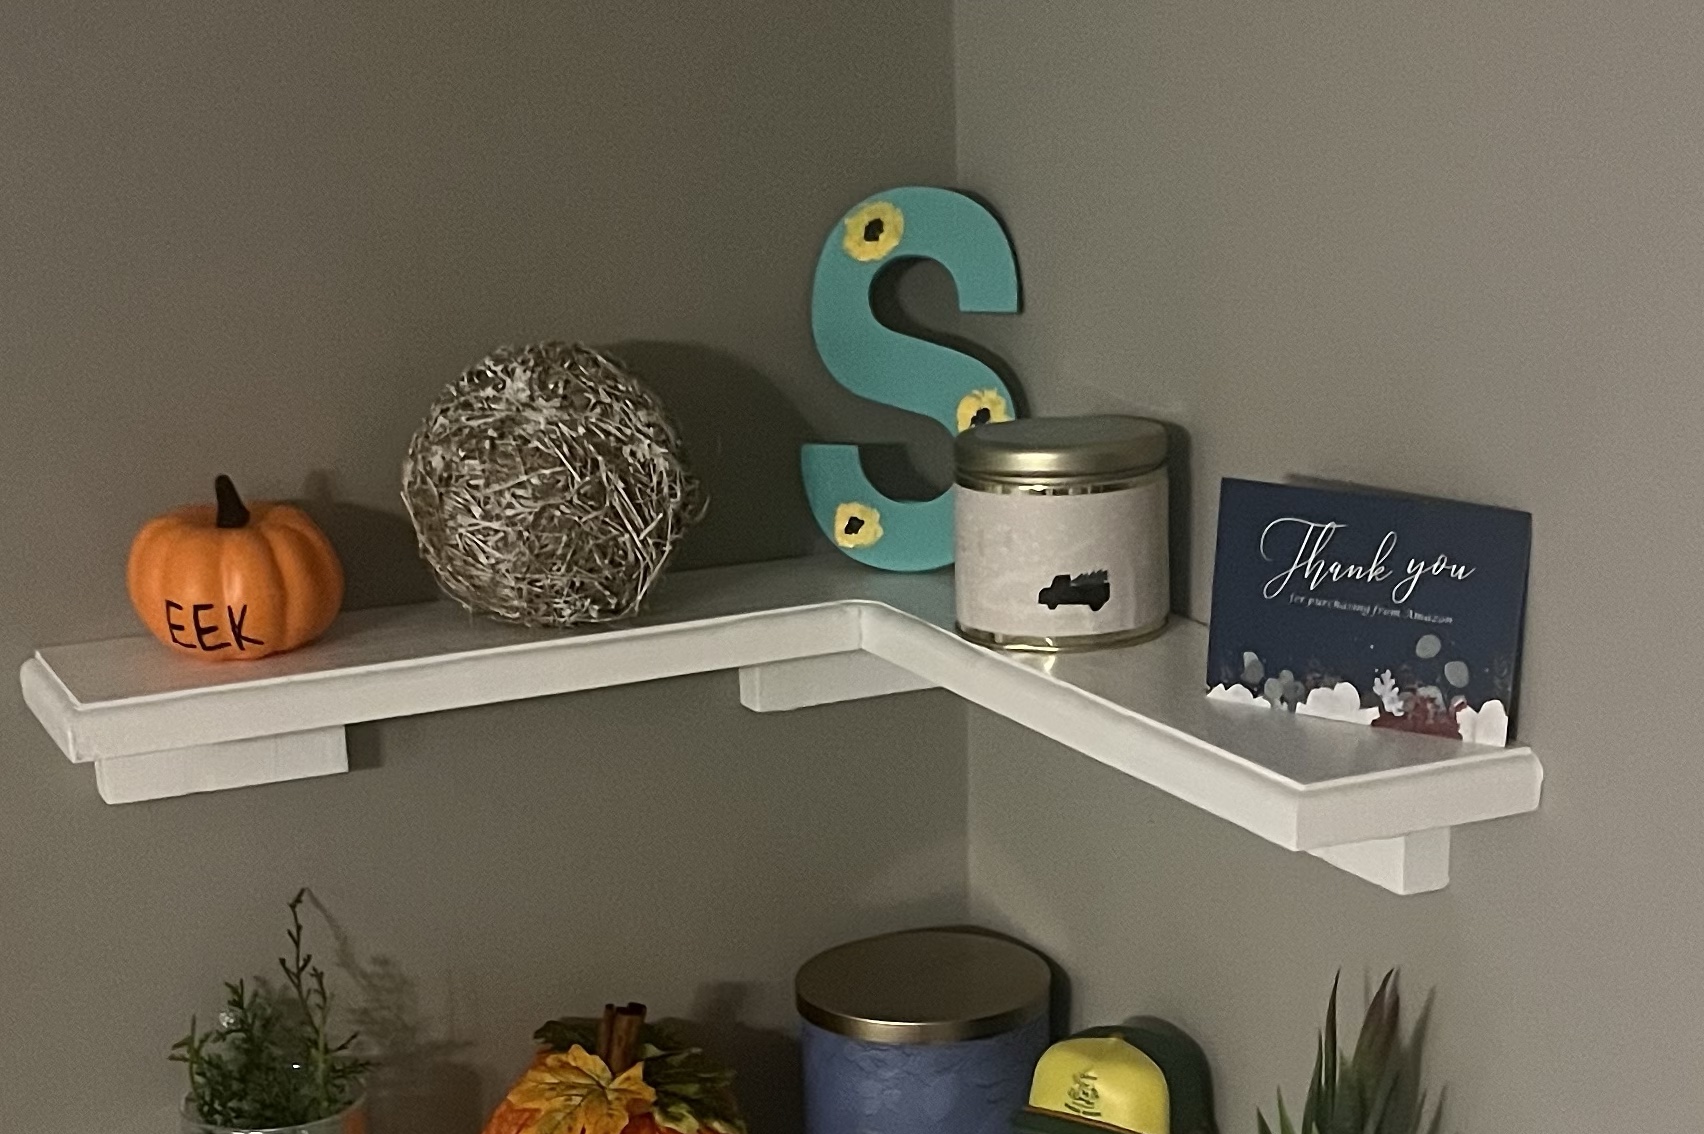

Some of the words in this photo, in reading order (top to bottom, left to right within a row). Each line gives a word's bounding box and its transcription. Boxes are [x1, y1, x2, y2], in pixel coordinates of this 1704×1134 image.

[800, 186, 1020, 572] S
[1260, 517, 1397, 600] Thank
[1392, 553, 1476, 604] you
[165, 599, 265, 651] EEK
[1406, 608, 1453, 624] Amazon
